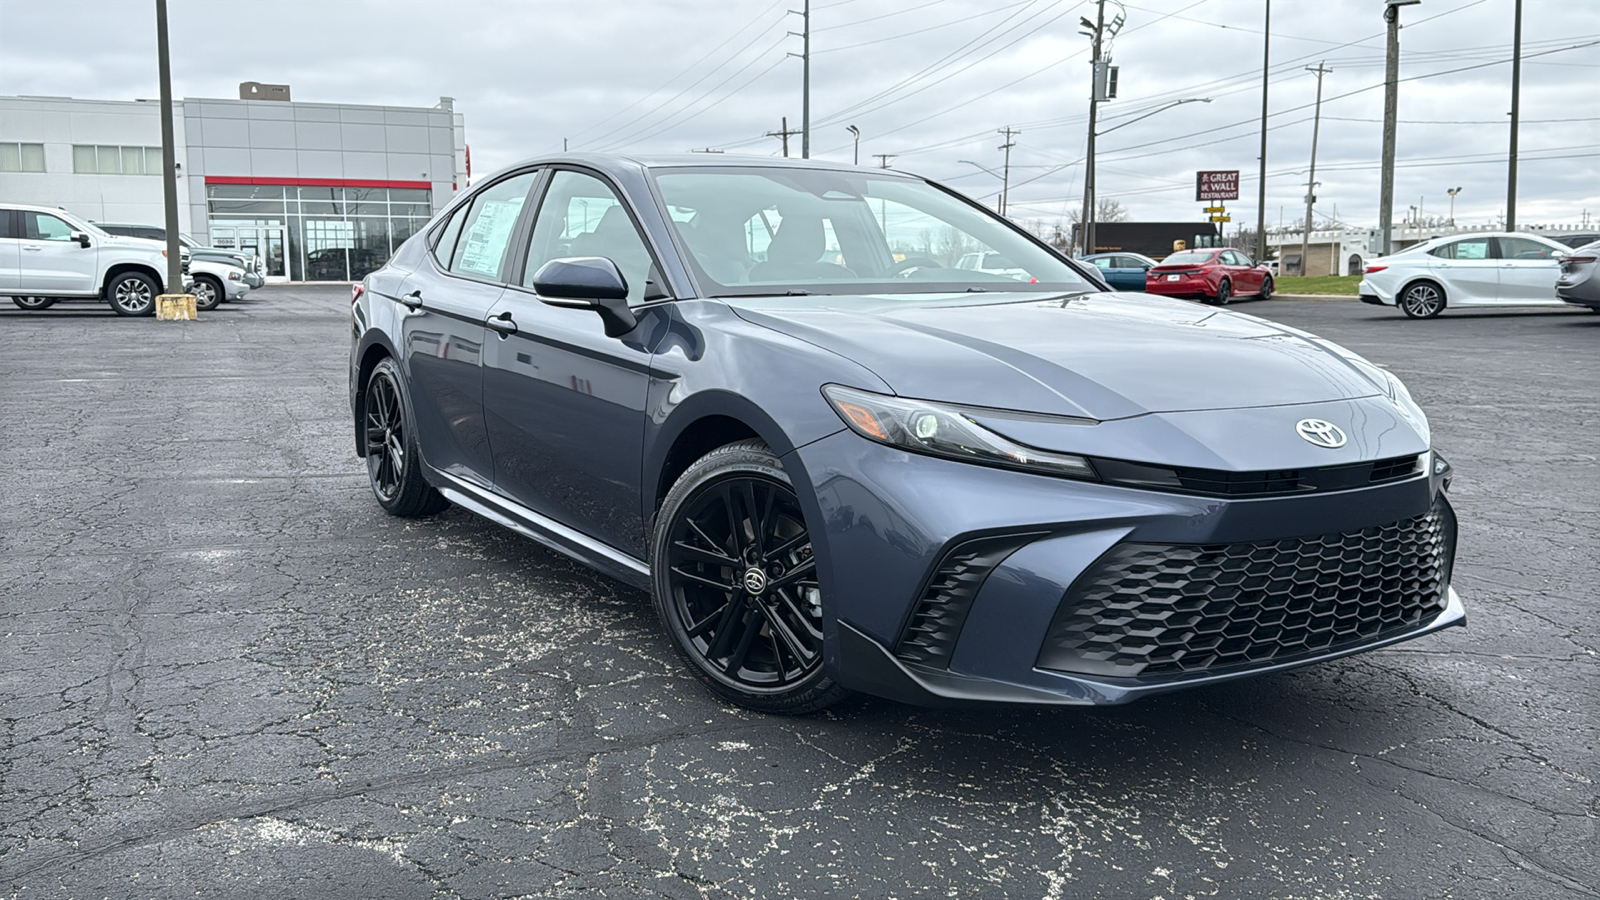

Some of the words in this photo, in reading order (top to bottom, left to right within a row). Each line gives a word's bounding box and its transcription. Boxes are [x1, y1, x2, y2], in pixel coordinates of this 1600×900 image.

[1210, 173, 1237, 182] GREAT
[1211, 182, 1236, 191] WALL
[1200, 191, 1237, 199] RESTAURANT
